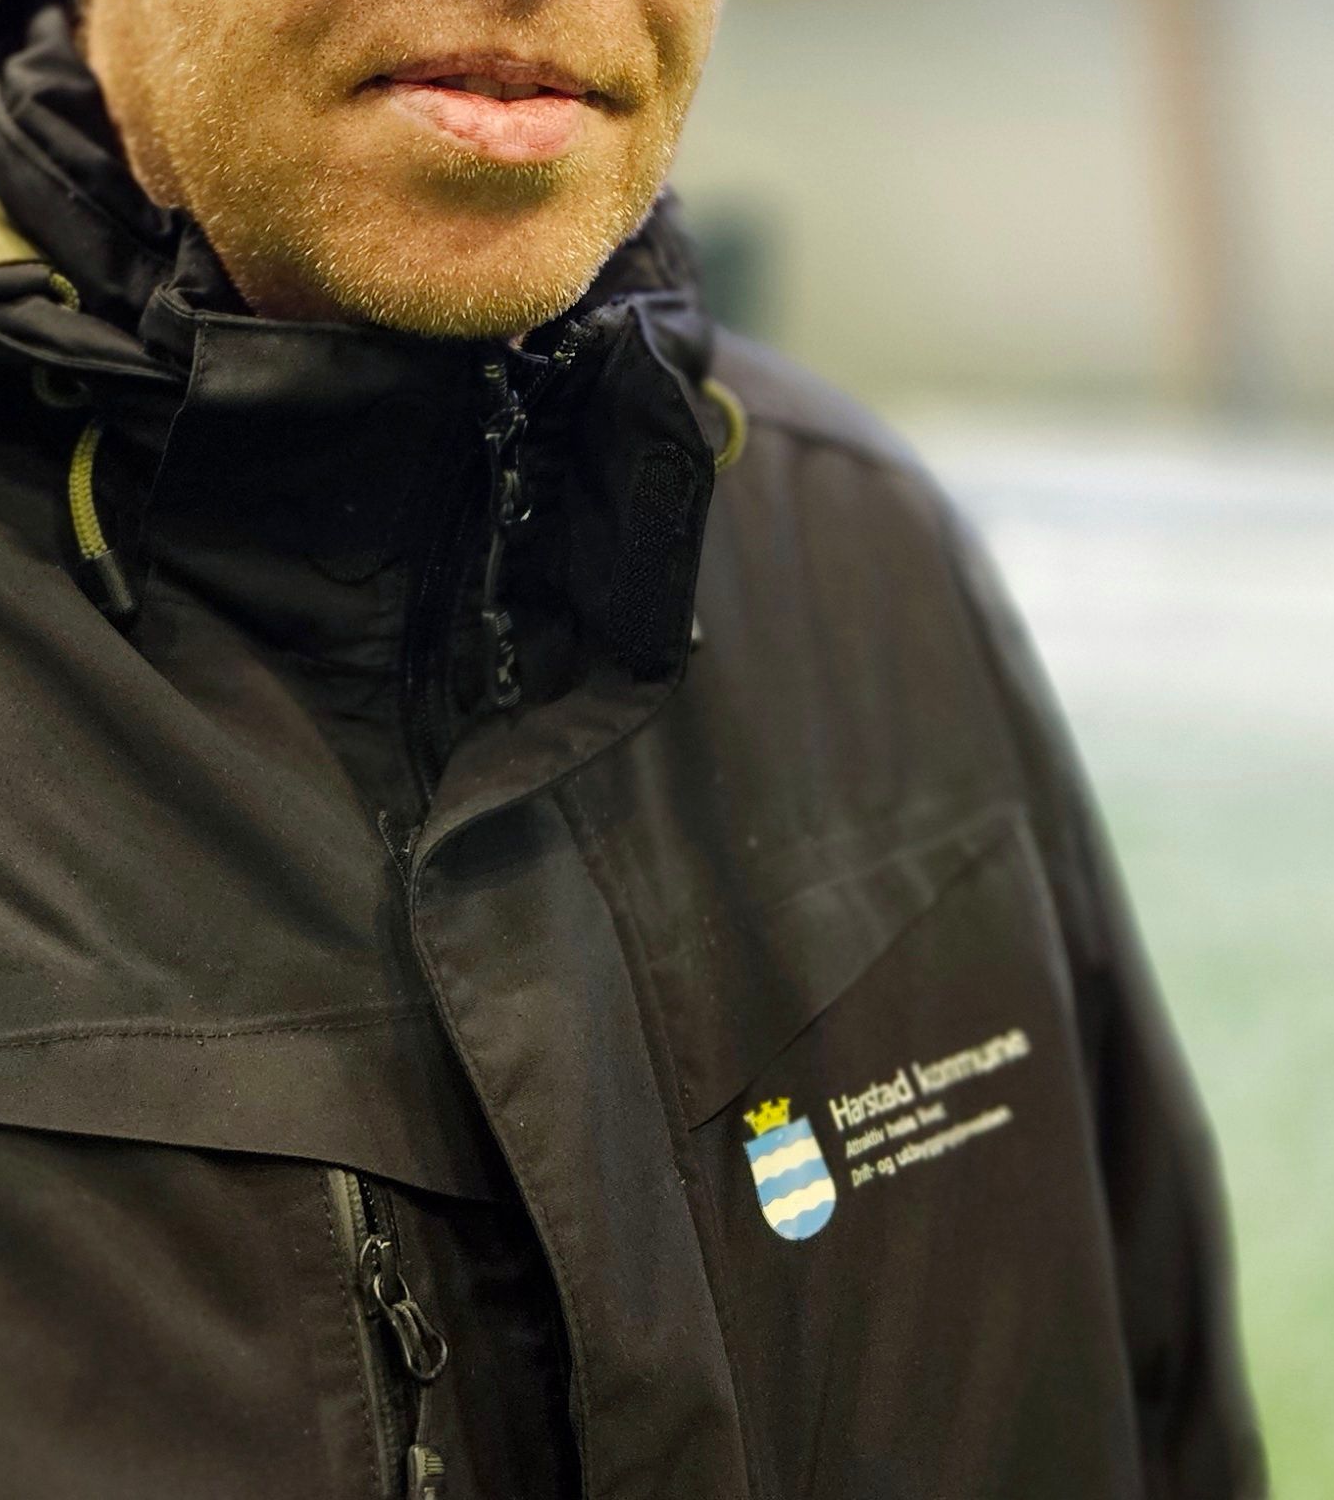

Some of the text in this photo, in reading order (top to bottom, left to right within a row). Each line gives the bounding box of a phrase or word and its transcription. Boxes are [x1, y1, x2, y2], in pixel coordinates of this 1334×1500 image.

[829, 1028, 1030, 1131] Harstad kommune
[877, 1156, 896, 1176] og
